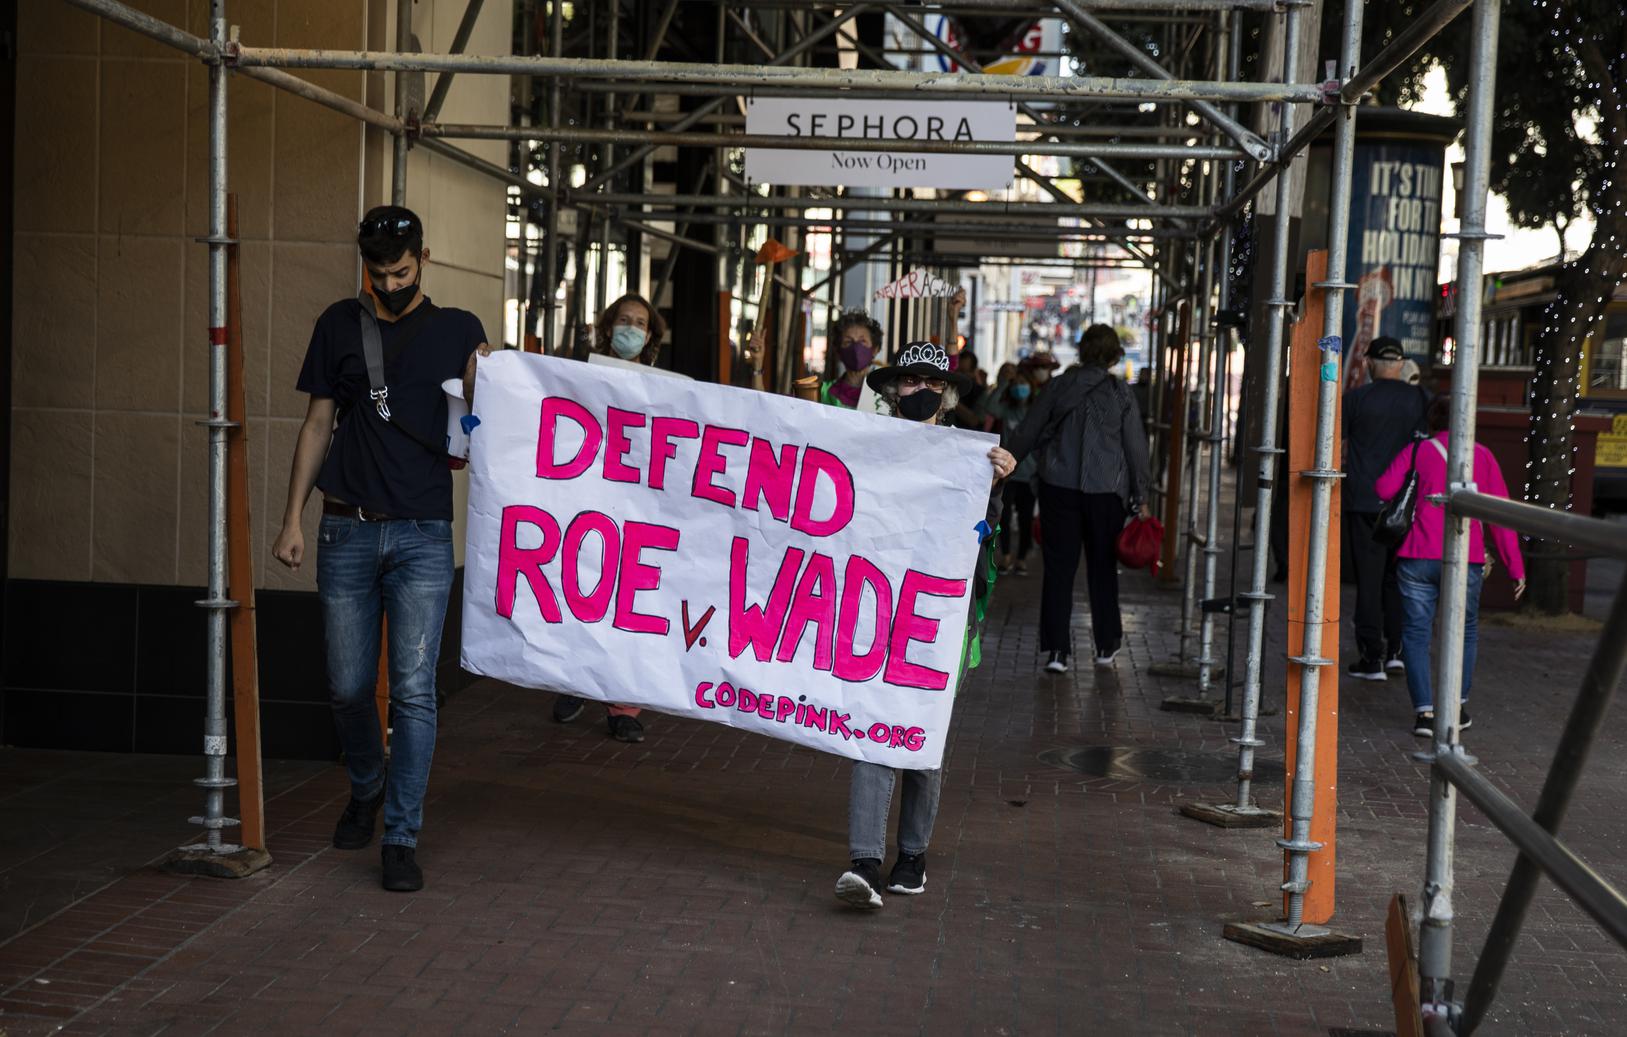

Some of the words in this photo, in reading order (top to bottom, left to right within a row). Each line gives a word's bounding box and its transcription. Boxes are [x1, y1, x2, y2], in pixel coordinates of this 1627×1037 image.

[786, 113, 974, 141] SEPHORA
[831, 152, 874, 170] Now
[877, 153, 927, 173] Open
[1371, 161, 1414, 197] IT'S
[1388, 197, 1422, 232] FOR
[876, 271, 921, 298] NEVER
[1393, 266, 1412, 300] IN
[536, 396, 855, 537] DEFEND
[495, 505, 680, 636] ROE
[728, 536, 967, 691] WADE
